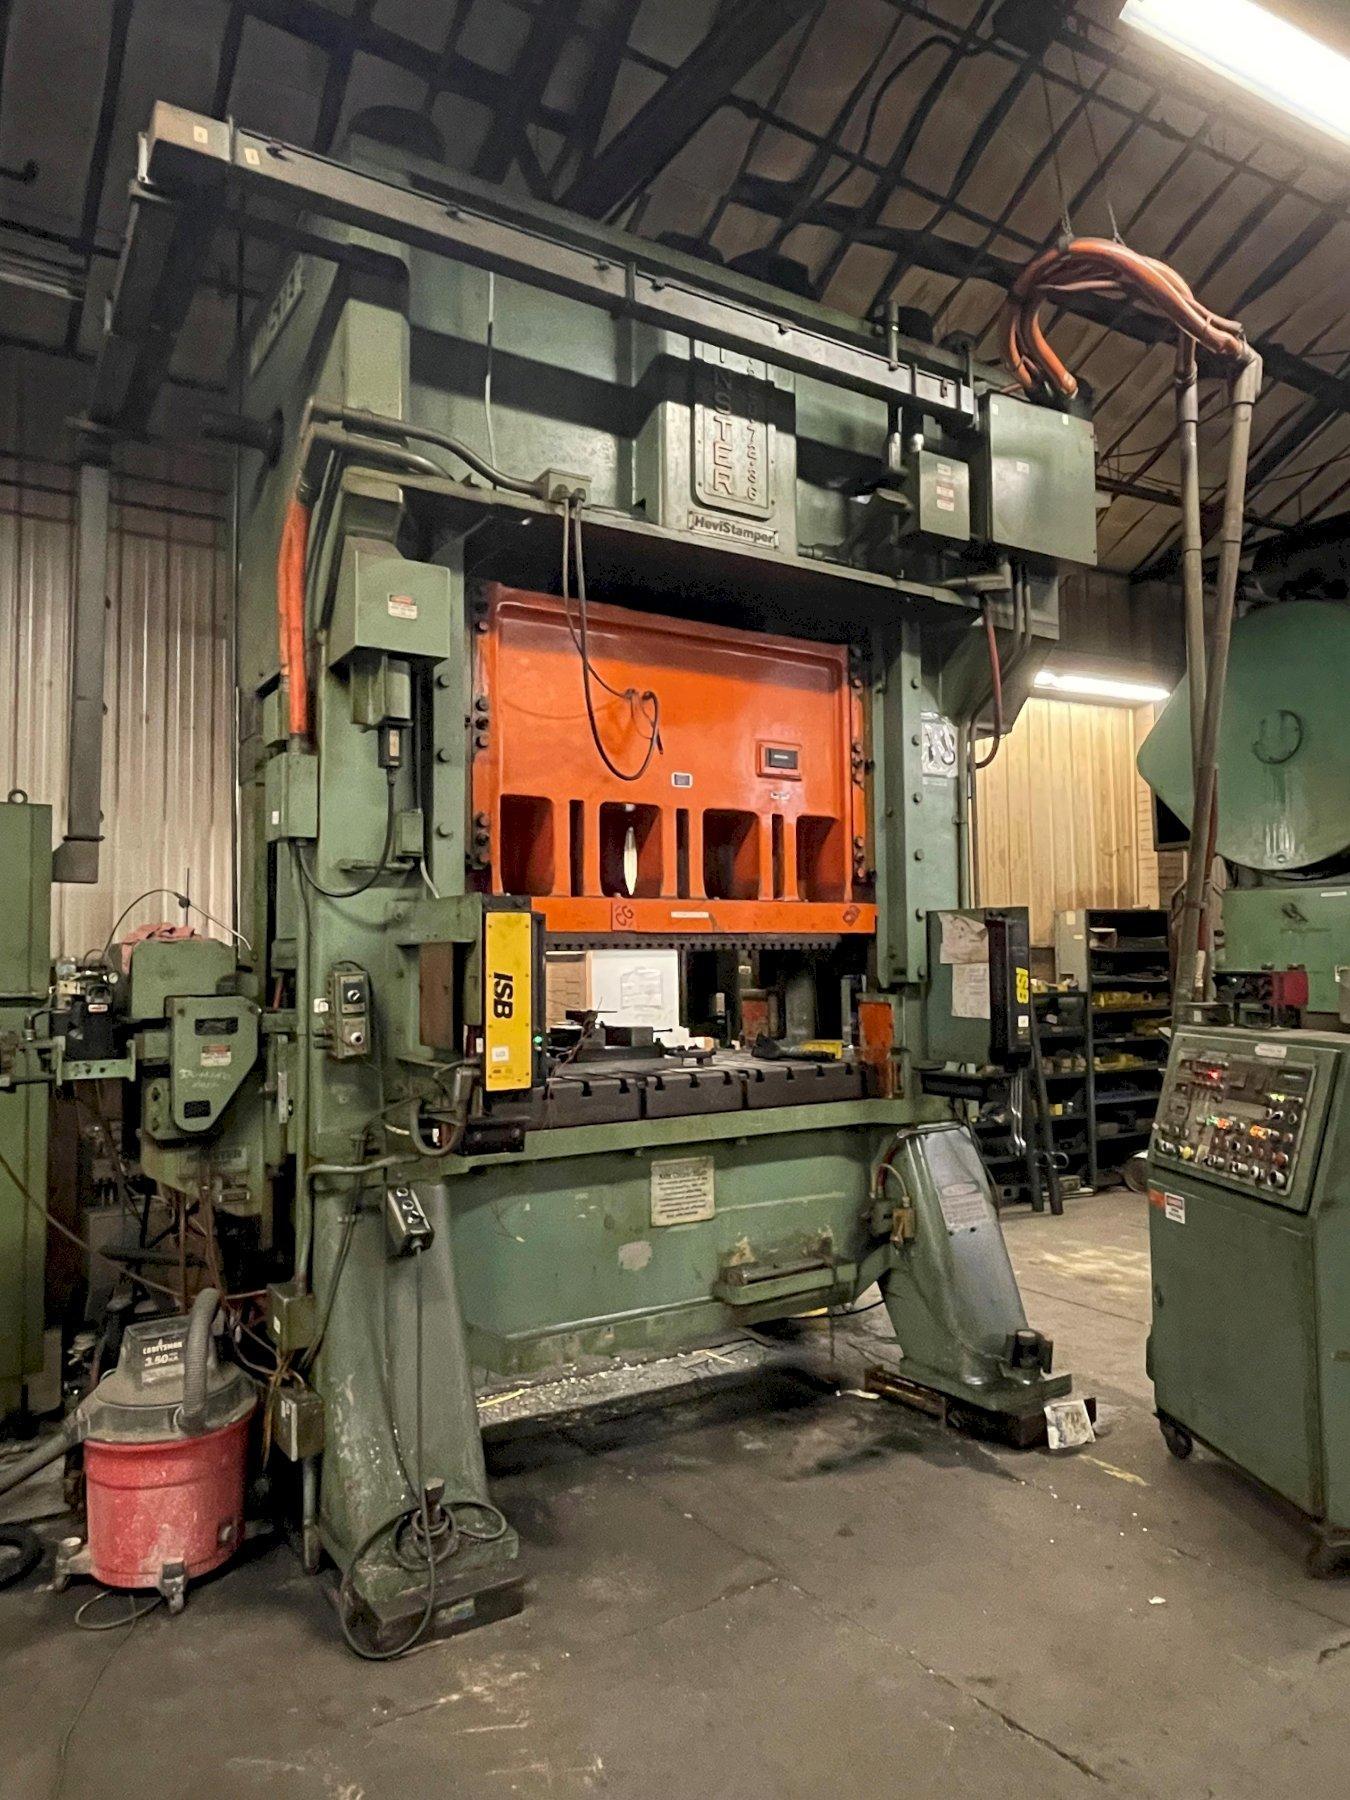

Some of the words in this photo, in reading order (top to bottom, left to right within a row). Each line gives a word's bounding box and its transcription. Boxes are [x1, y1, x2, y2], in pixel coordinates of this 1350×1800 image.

[713, 347, 733, 496] INSTER
[694, 516, 774, 543] HeviStamper
[493, 971, 514, 1019] ISB
